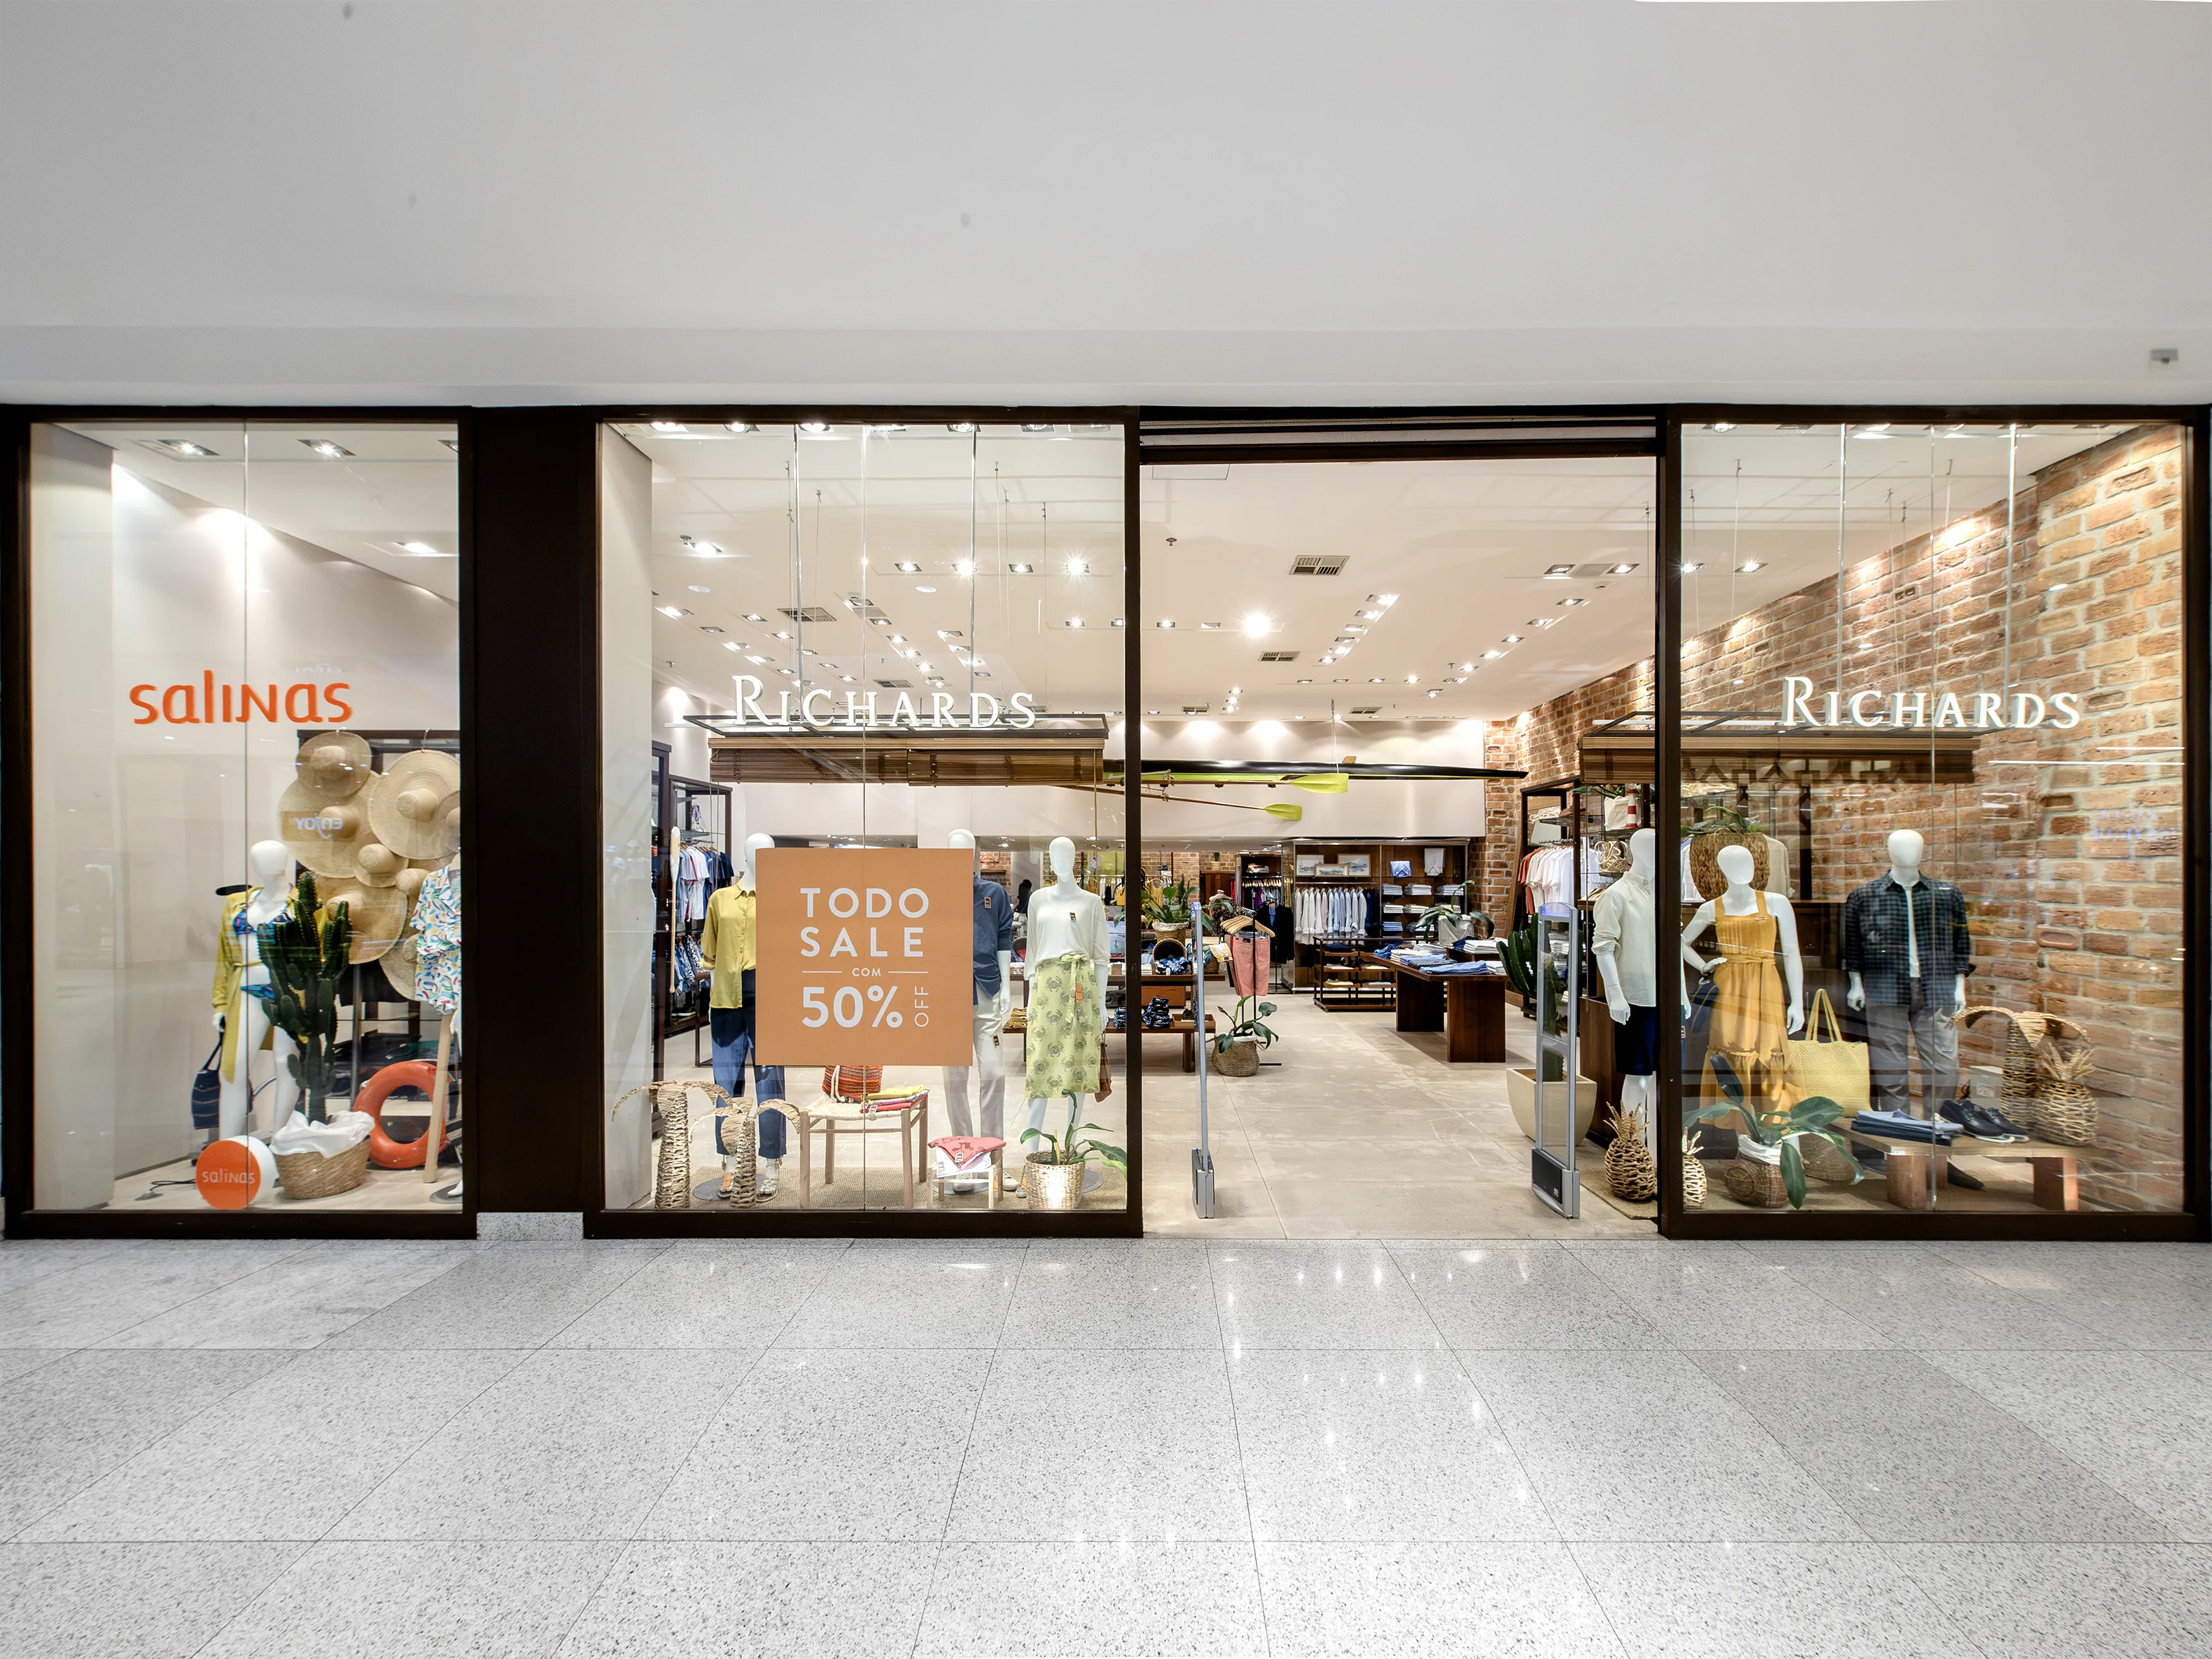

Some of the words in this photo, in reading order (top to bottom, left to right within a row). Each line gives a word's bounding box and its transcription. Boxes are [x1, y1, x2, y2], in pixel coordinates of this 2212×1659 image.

[731, 675, 1036, 729] RICHARDS
[1782, 676, 2081, 729] RICHARDS
[800, 887, 929, 918] TODO
[800, 927, 924, 957] SALE
[851, 968, 882, 978] COM
[801, 985, 903, 1028] 50%
[914, 985, 929, 1028] OFF
